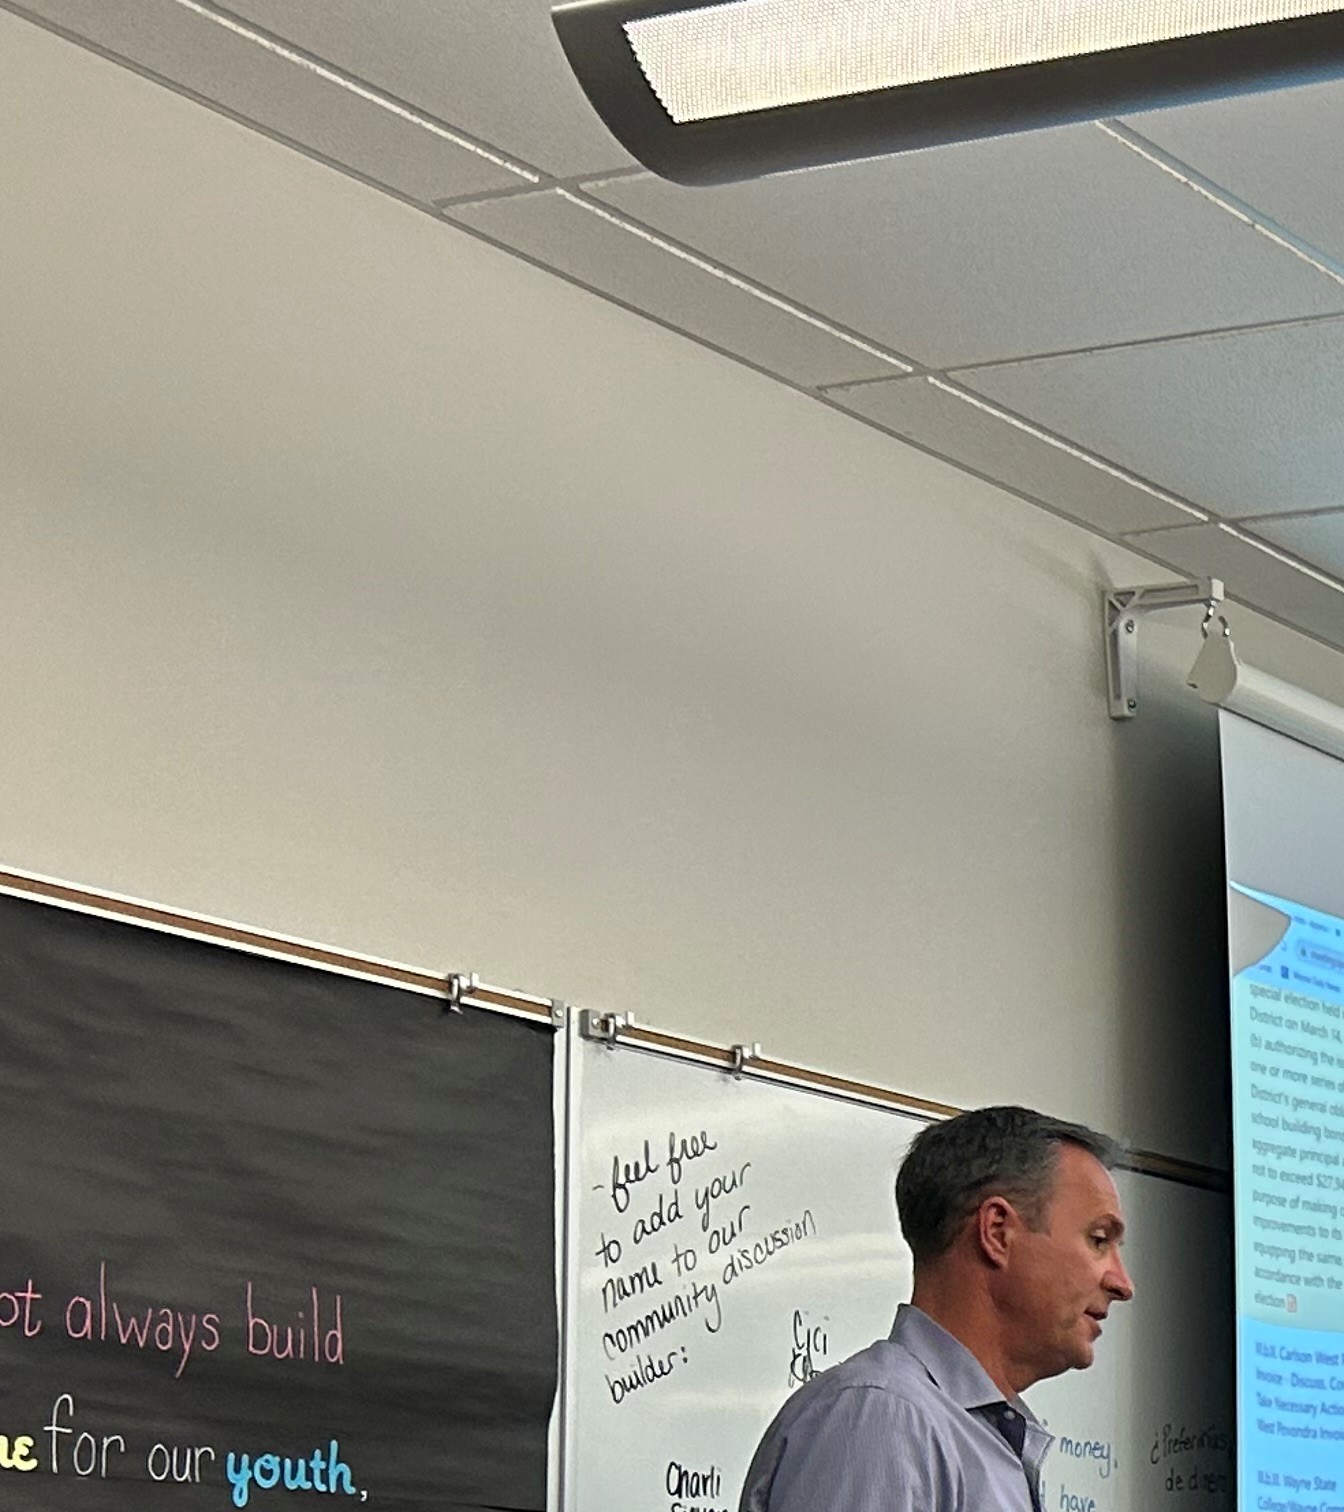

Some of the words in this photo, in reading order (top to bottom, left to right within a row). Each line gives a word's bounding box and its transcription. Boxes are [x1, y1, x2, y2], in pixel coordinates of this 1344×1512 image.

[667, 1131, 718, 1185] free
[595, 1232, 622, 1268] to
[633, 1189, 683, 1244] add
[695, 1162, 751, 1232] your
[601, 1262, 663, 1313] name
[671, 1243, 697, 1277] to
[708, 1206, 751, 1254] our
[66, 1261, 221, 1379] always
[247, 1280, 345, 1365] build
[602, 1282, 722, 1361] community
[722, 1210, 817, 1285] discussion
[605, 1346, 688, 1404] builder:
[43, 1393, 125, 1478] for
[148, 1442, 216, 1483] our
[225, 1439, 369, 1509] youth,
[666, 1461, 722, 1499] Charli
